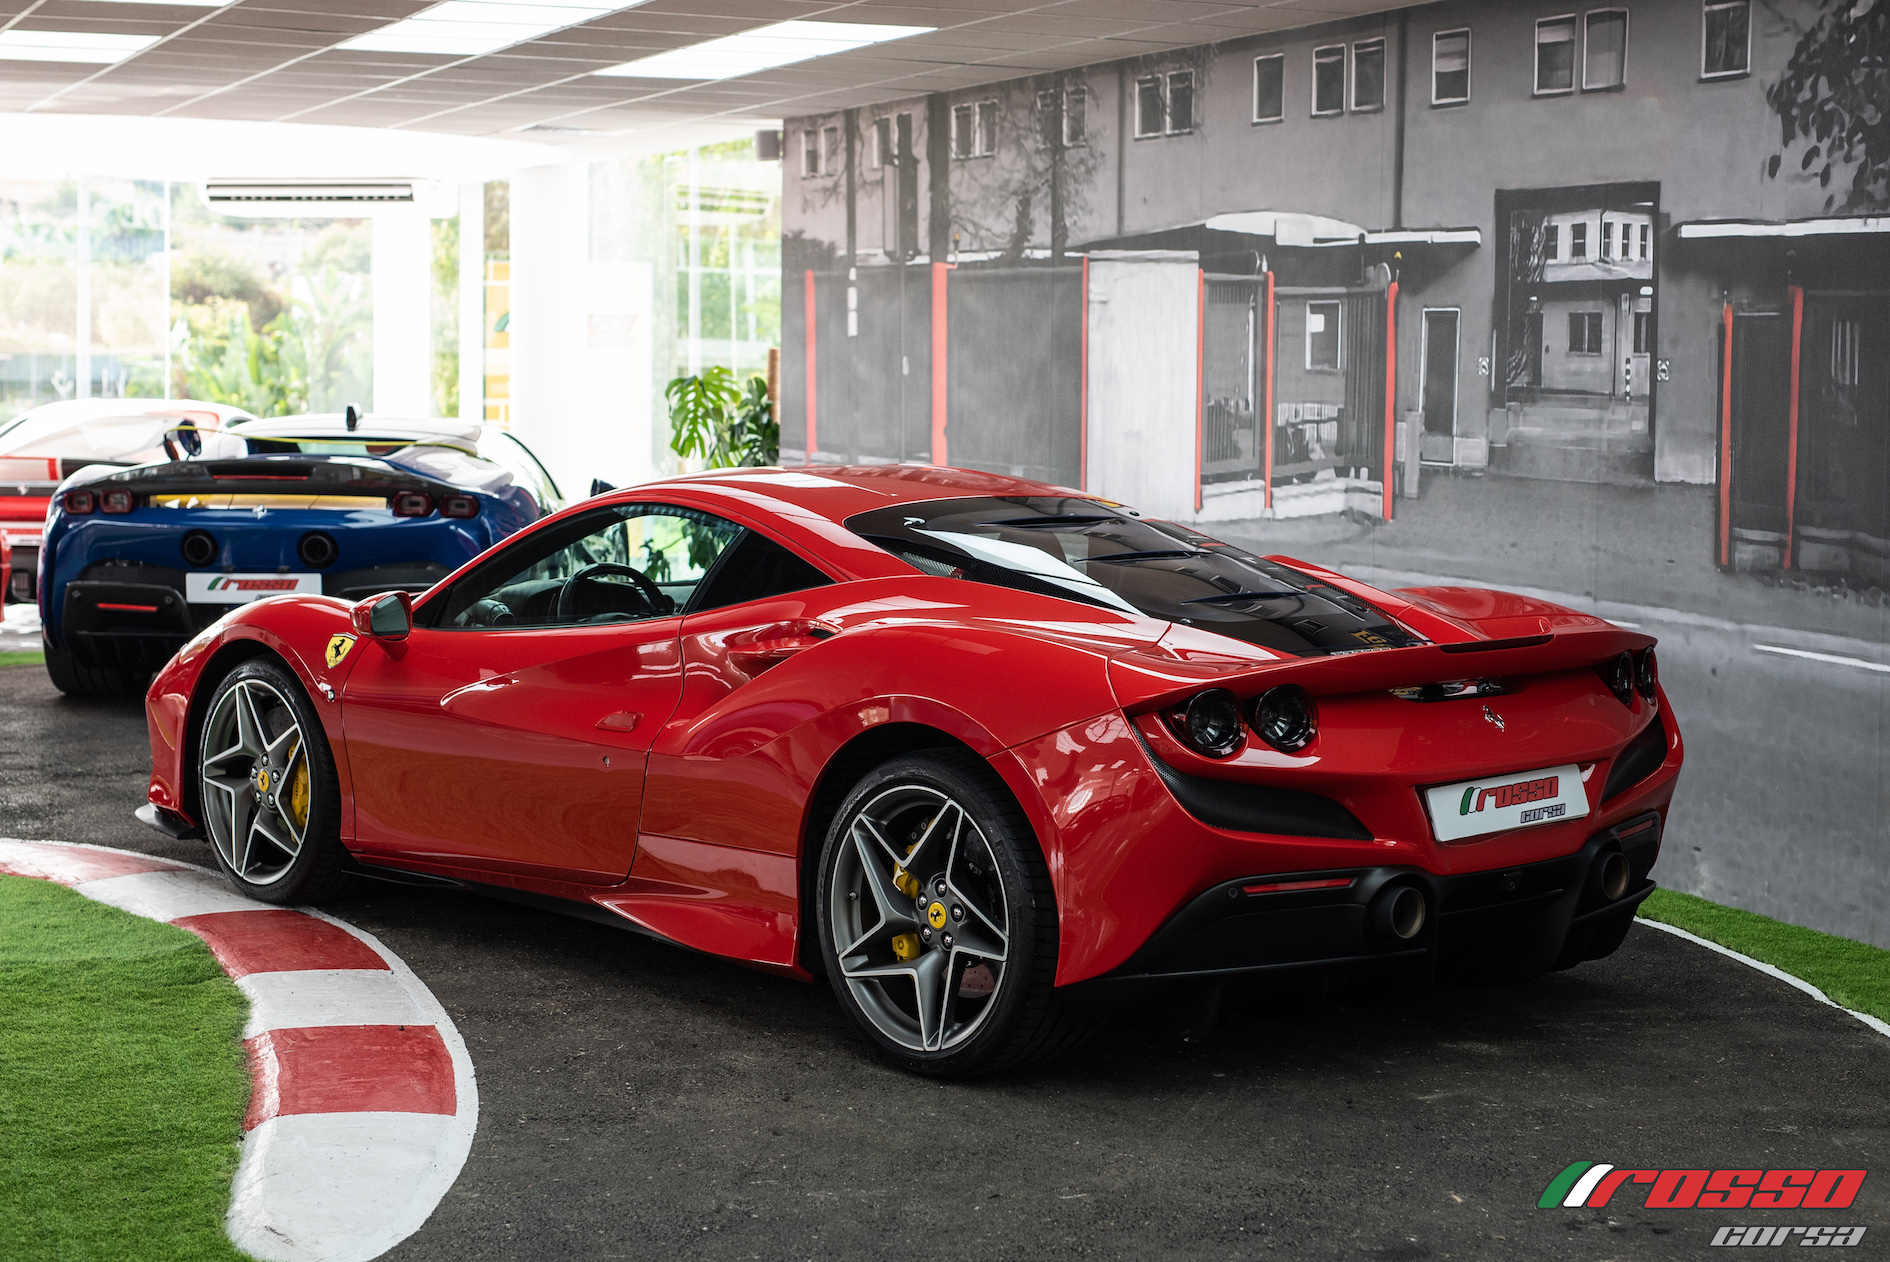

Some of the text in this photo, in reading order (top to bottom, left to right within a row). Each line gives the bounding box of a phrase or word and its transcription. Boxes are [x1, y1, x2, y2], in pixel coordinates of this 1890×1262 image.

[220, 578, 299, 591] rosso
[1476, 776, 1559, 812] rosso
[1520, 803, 1566, 824] corsa
